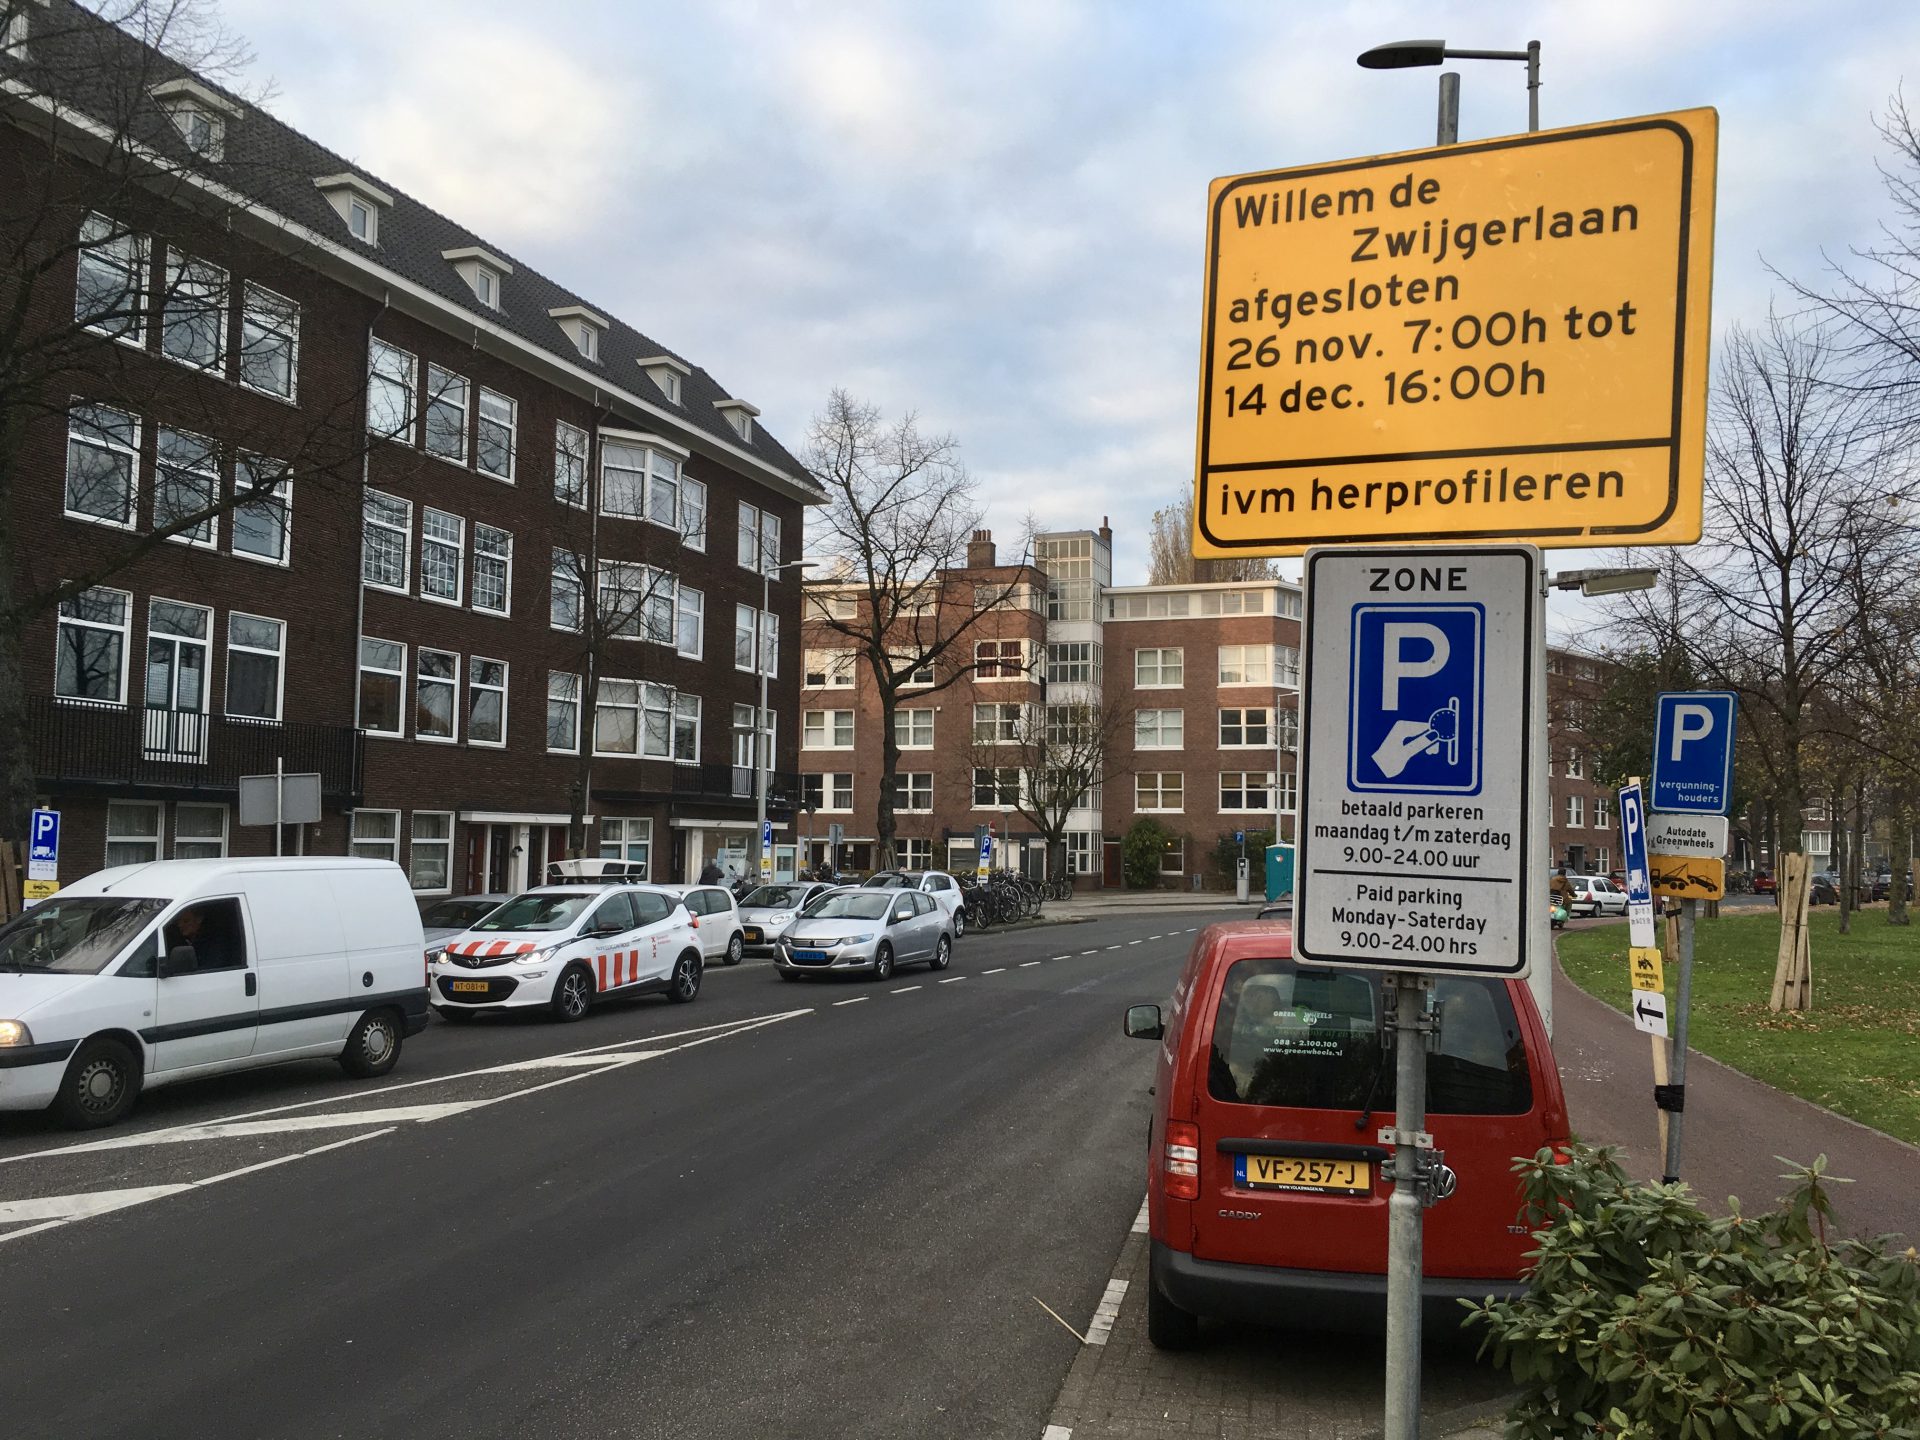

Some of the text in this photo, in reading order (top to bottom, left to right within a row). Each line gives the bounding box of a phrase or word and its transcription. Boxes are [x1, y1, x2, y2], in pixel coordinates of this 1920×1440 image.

[1235, 172, 1441, 229] Willem de
[1351, 203, 1639, 264] Zwijgerlaan
[1229, 274, 1460, 329] afgesloten
[1226, 300, 1637, 371] 26 nov. 7:00h tot
[1224, 360, 1545, 418] 14 dec. 16:00h
[1221, 467, 1625, 516] ivm herprofileren
[1369, 567, 1468, 592] ZONE
[1382, 622, 1451, 711] P
[1671, 703, 1714, 761] P
[1660, 781, 1720, 793] vergunning-
[1677, 793, 1719, 803] houders
[1341, 800, 1483, 821] betaald parkeren
[38, 814, 54, 840] P
[1315, 824, 1511, 850] maandag t/m zaterdag
[1625, 798, 1639, 856] P
[1666, 826, 1707, 838] Autodate
[1656, 835, 1714, 849] Greenwheels
[1343, 846, 1480, 868] 9.00-24.00 uur
[1356, 884, 1462, 910] Paid parking
[1332, 906, 1487, 934] Monday-Saterday
[1341, 931, 1477, 955] 9.00-24.00 hrs
[1256, 1158, 1355, 1186] VF-257-J
[1218, 1209, 1262, 1220] CADDY
